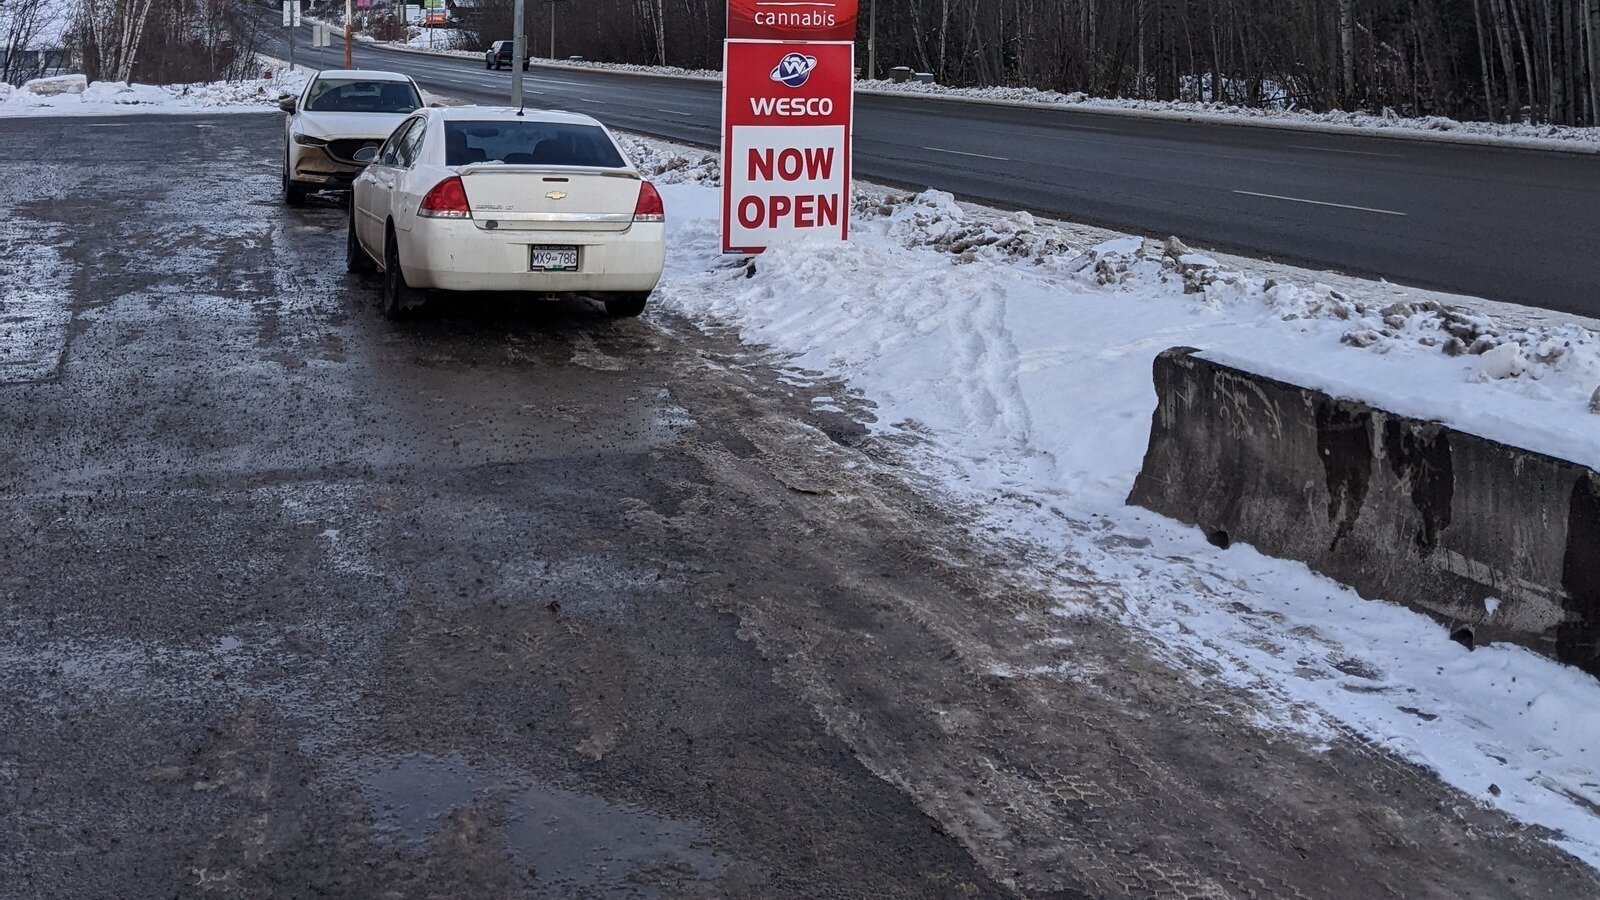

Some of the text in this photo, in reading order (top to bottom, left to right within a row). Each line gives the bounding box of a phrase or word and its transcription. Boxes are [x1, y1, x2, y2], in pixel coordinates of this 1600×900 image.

[754, 10, 835, 27] cannabis
[750, 97, 833, 116] WESCO
[747, 147, 835, 181] NOW
[737, 193, 839, 230] OPEN
